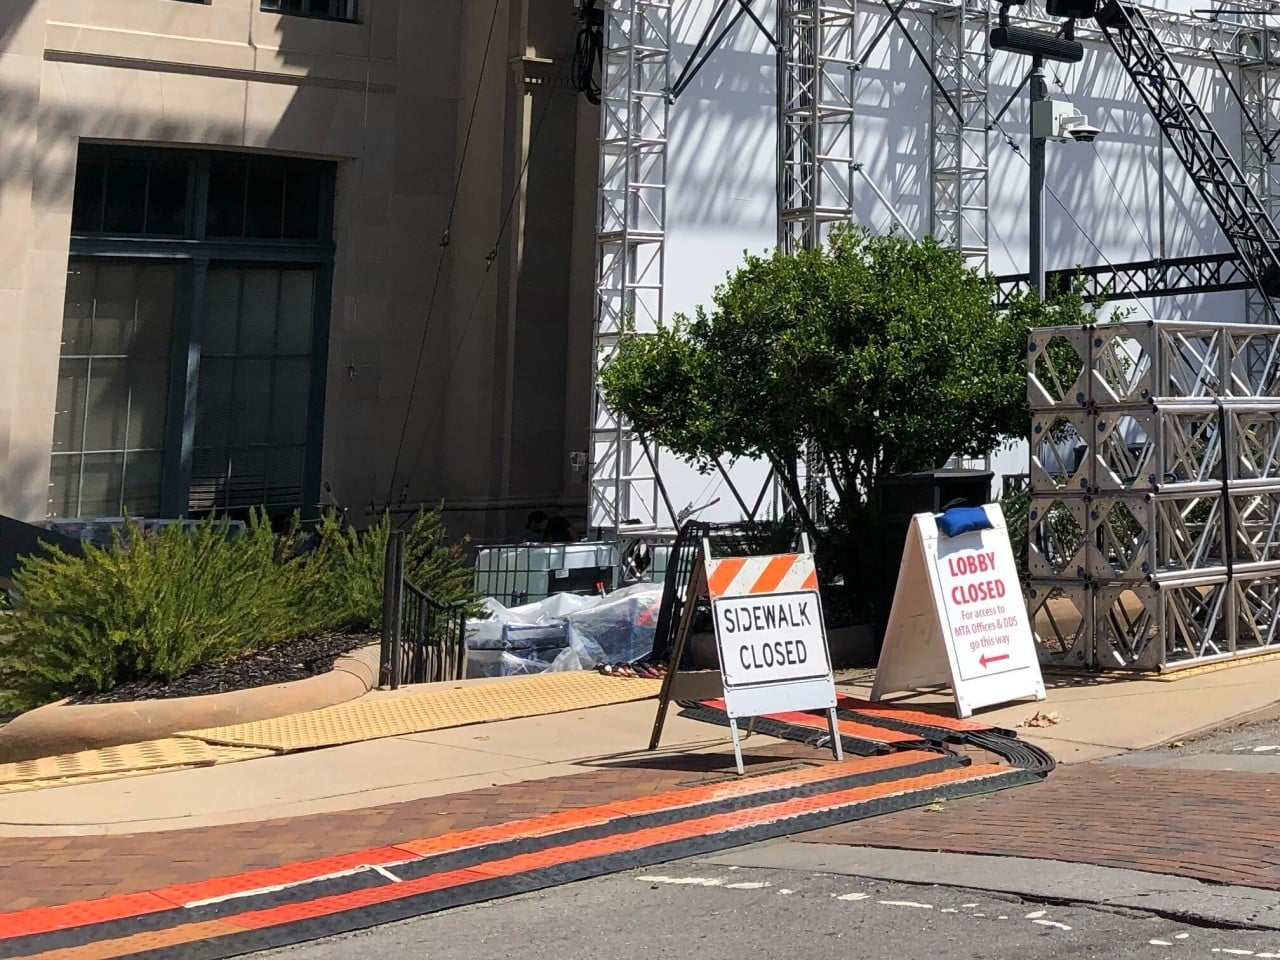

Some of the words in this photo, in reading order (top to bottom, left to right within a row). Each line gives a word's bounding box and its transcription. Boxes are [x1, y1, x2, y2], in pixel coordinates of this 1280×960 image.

[949, 552, 995, 578] LOBBY
[951, 579, 1006, 605] CLOSED
[724, 601, 811, 633] SIDEWALK
[961, 610, 973, 621] For
[975, 607, 997, 619] access
[997, 605, 1006, 615] to
[954, 624, 971, 637] MTA
[971, 620, 996, 634] Offices
[996, 619, 1003, 629] &
[1003, 616, 1018, 628] DDS
[739, 640, 807, 670] CLOSED
[970, 640, 980, 652] go
[980, 636, 995, 648] this
[995, 634, 1010, 646] way
